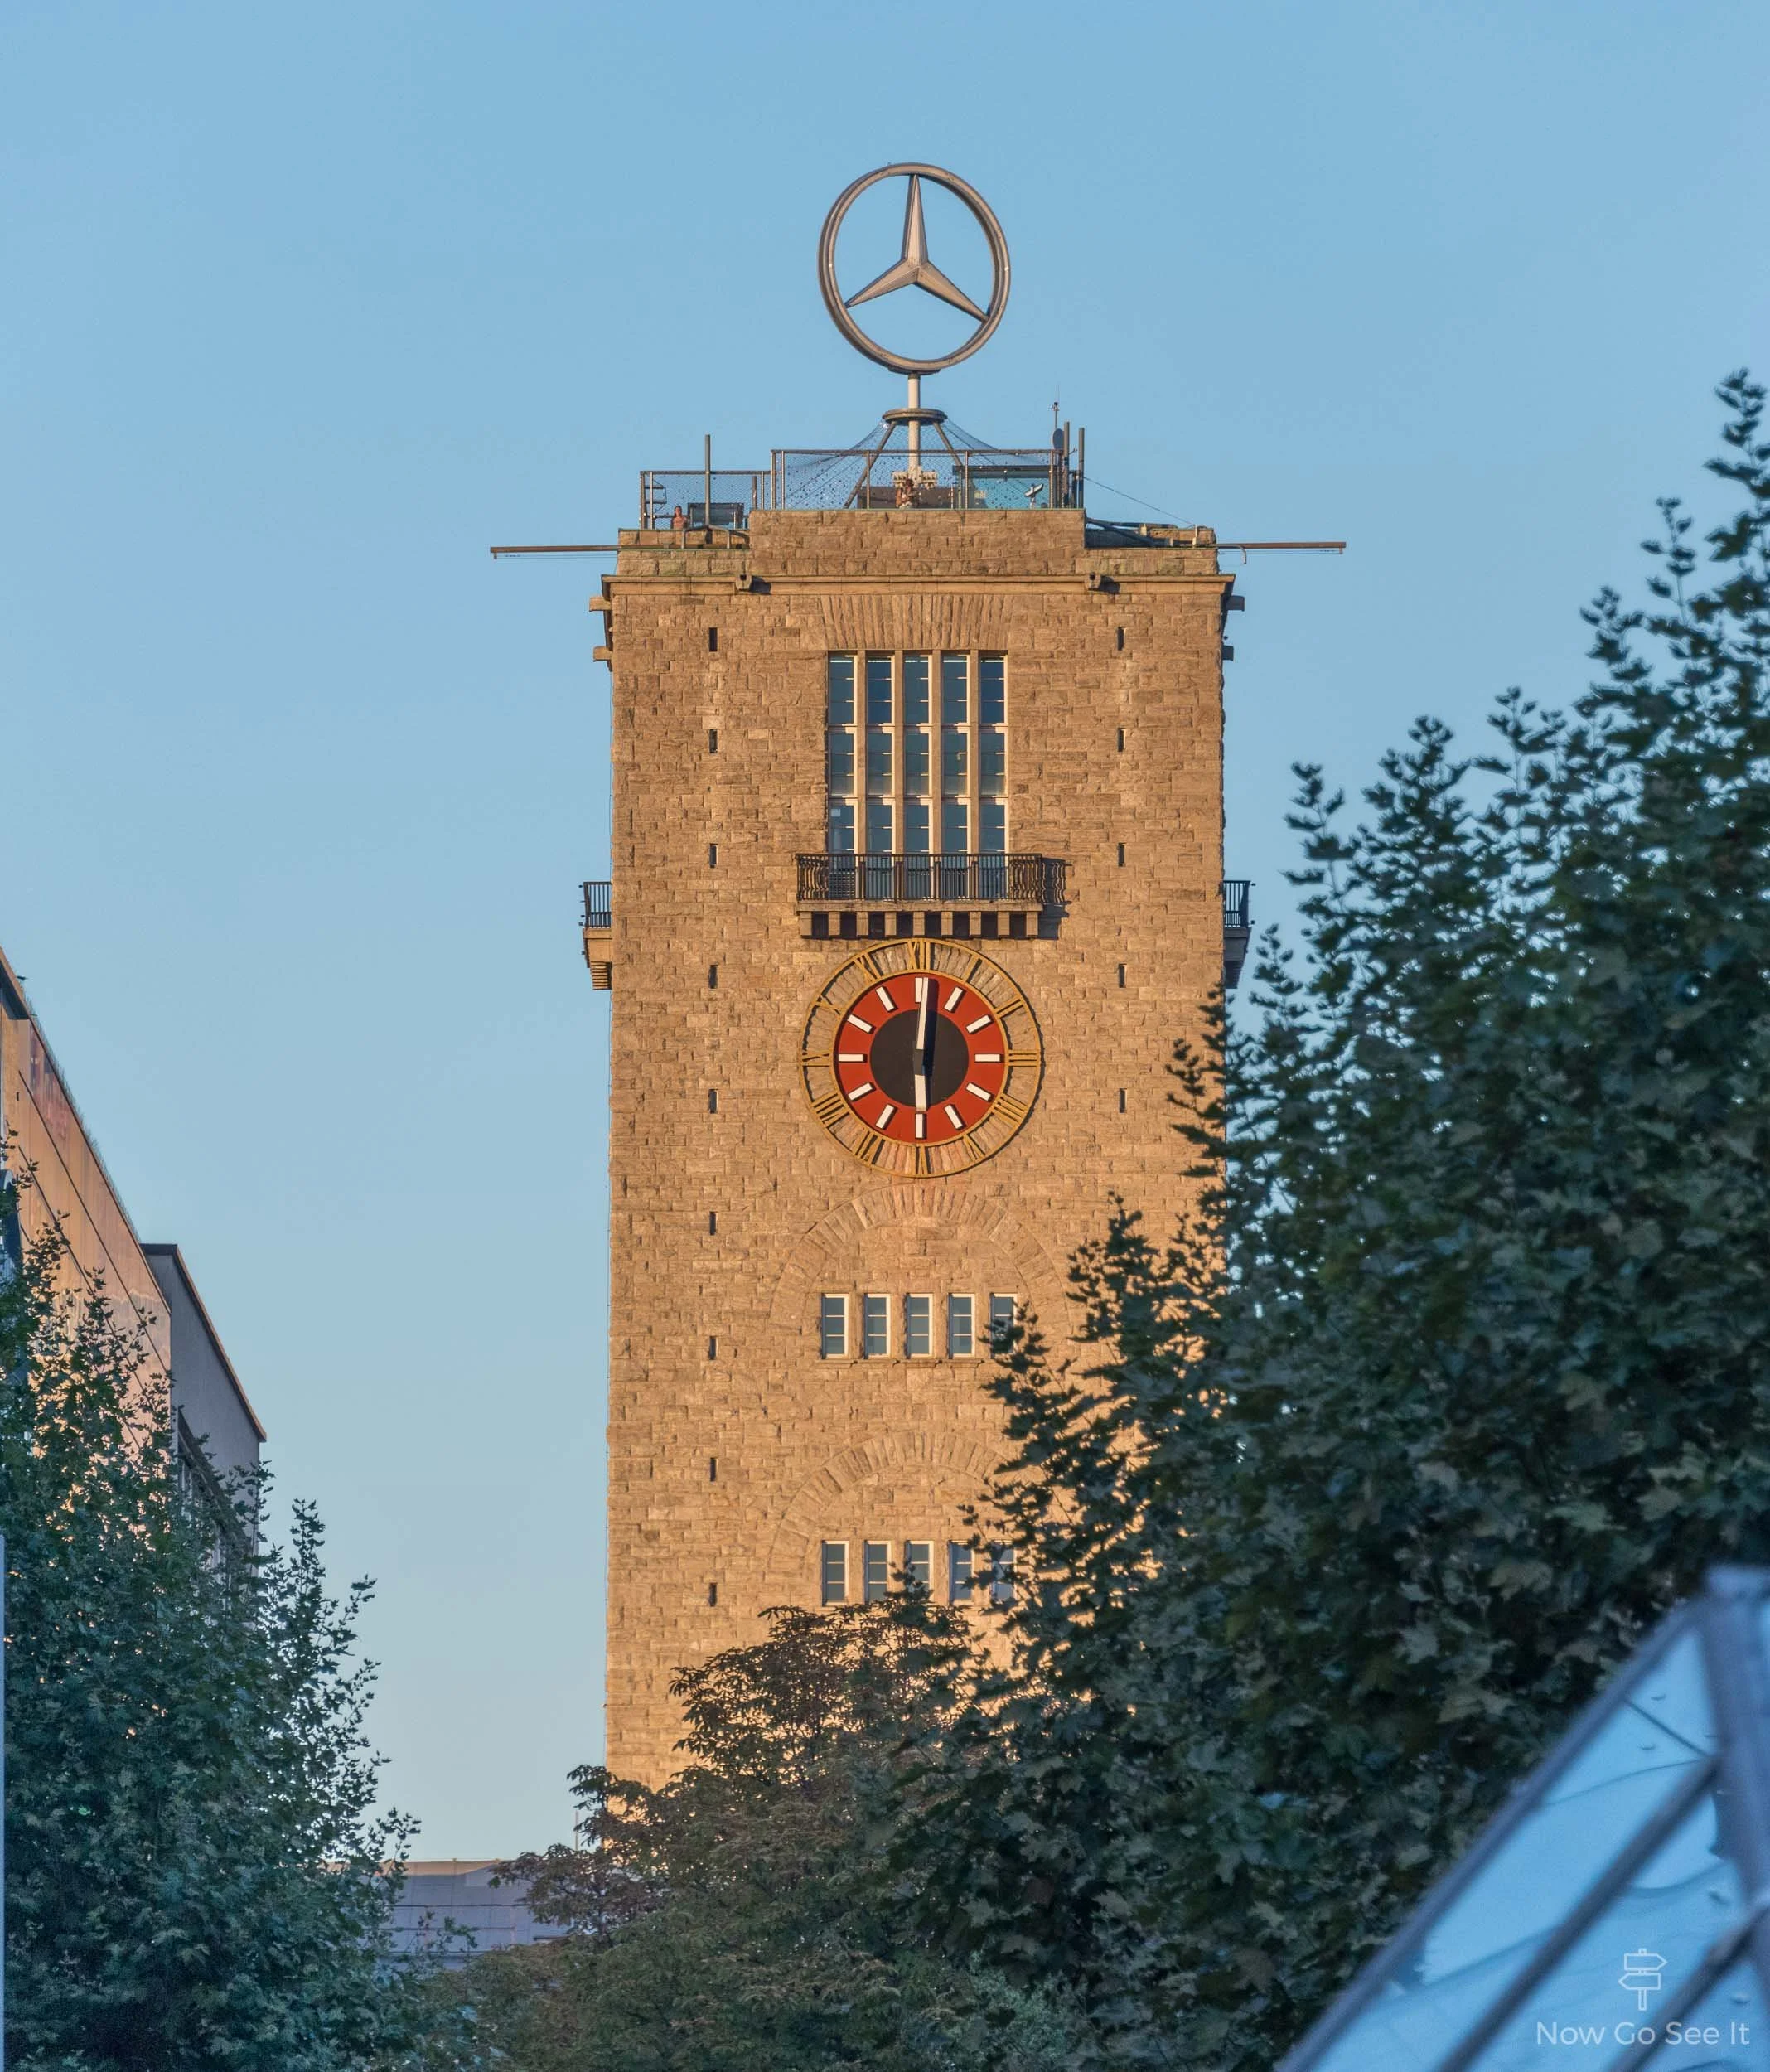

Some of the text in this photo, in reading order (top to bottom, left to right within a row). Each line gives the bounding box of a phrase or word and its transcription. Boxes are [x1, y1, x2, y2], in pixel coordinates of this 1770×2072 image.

[854, 953, 882, 985] XI
[907, 940, 931, 970] XII
[961, 953, 980, 983] I
[815, 995, 844, 1015] X
[995, 995, 1024, 1019] II
[802, 1052, 829, 1067] IX
[1008, 1050, 1037, 1067] III
[812, 1092, 849, 1127] VIII
[993, 1092, 1028, 1127] IIII
[853, 1130, 883, 1164] VII
[912, 1145, 929, 1174] VI
[962, 1135, 986, 1162] V
